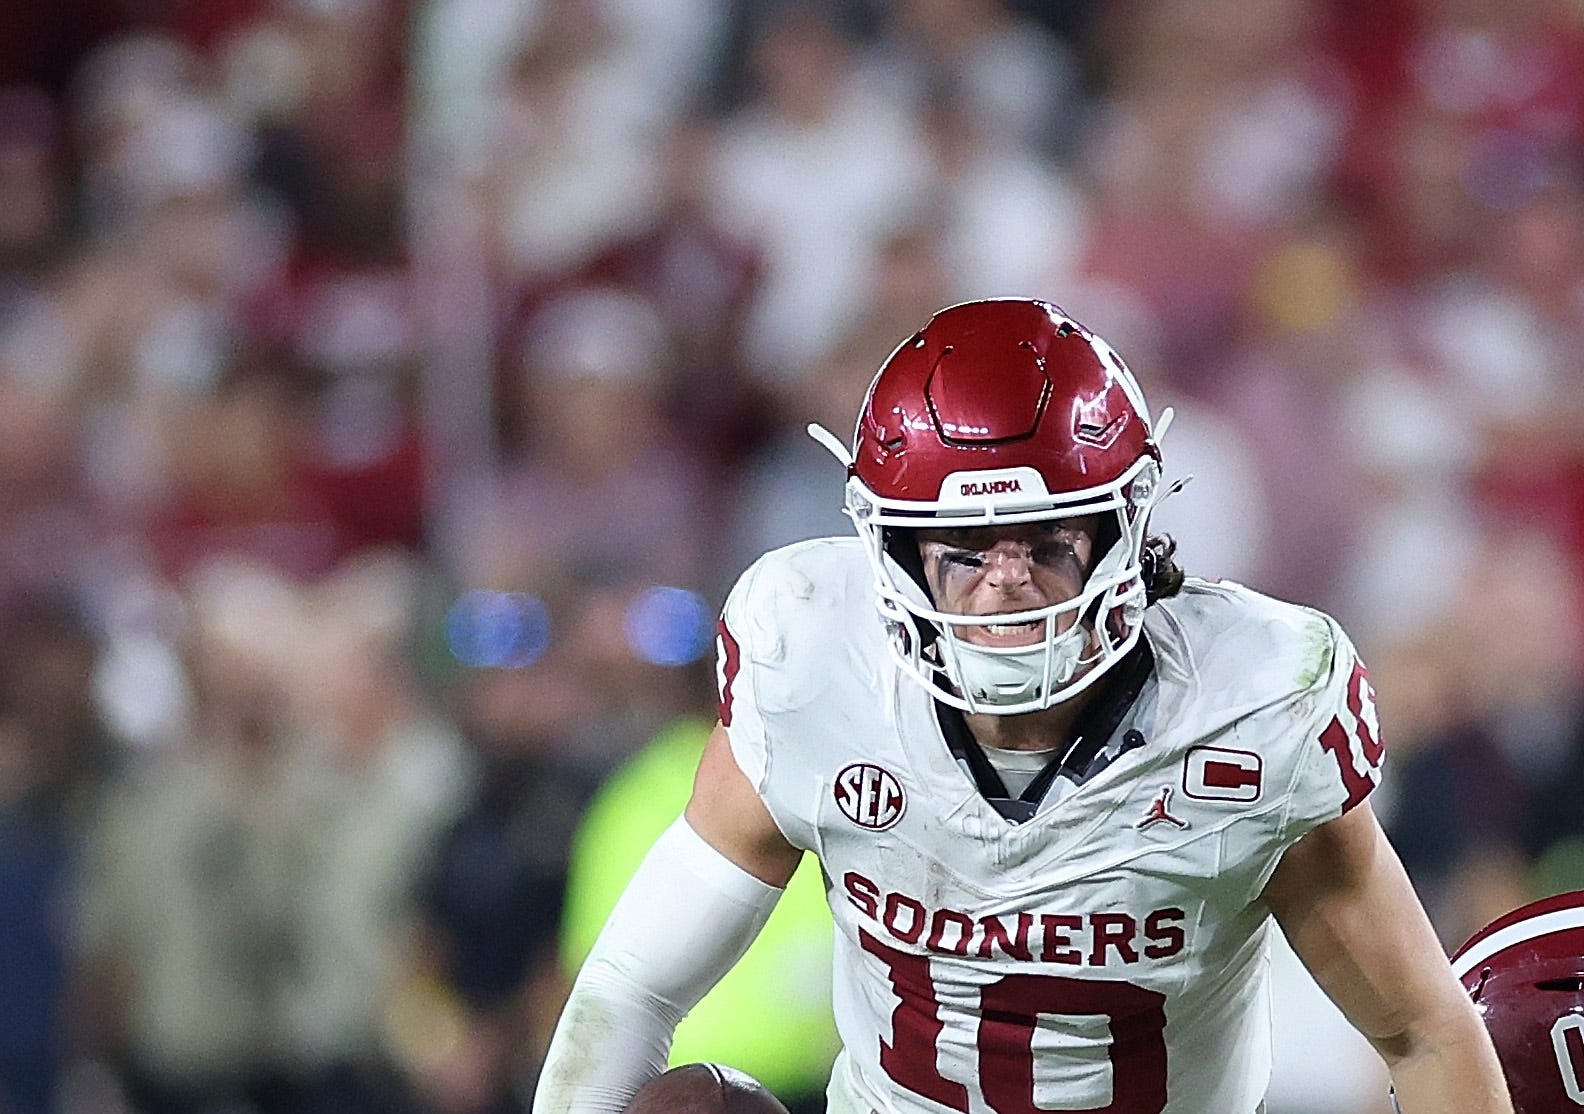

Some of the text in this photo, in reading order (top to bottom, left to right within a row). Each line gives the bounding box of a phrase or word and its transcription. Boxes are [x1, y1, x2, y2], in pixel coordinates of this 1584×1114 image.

[960, 480, 1021, 496] OKLAHOMA
[837, 764, 902, 828] SEC
[843, 871, 1186, 967] SOONERS
